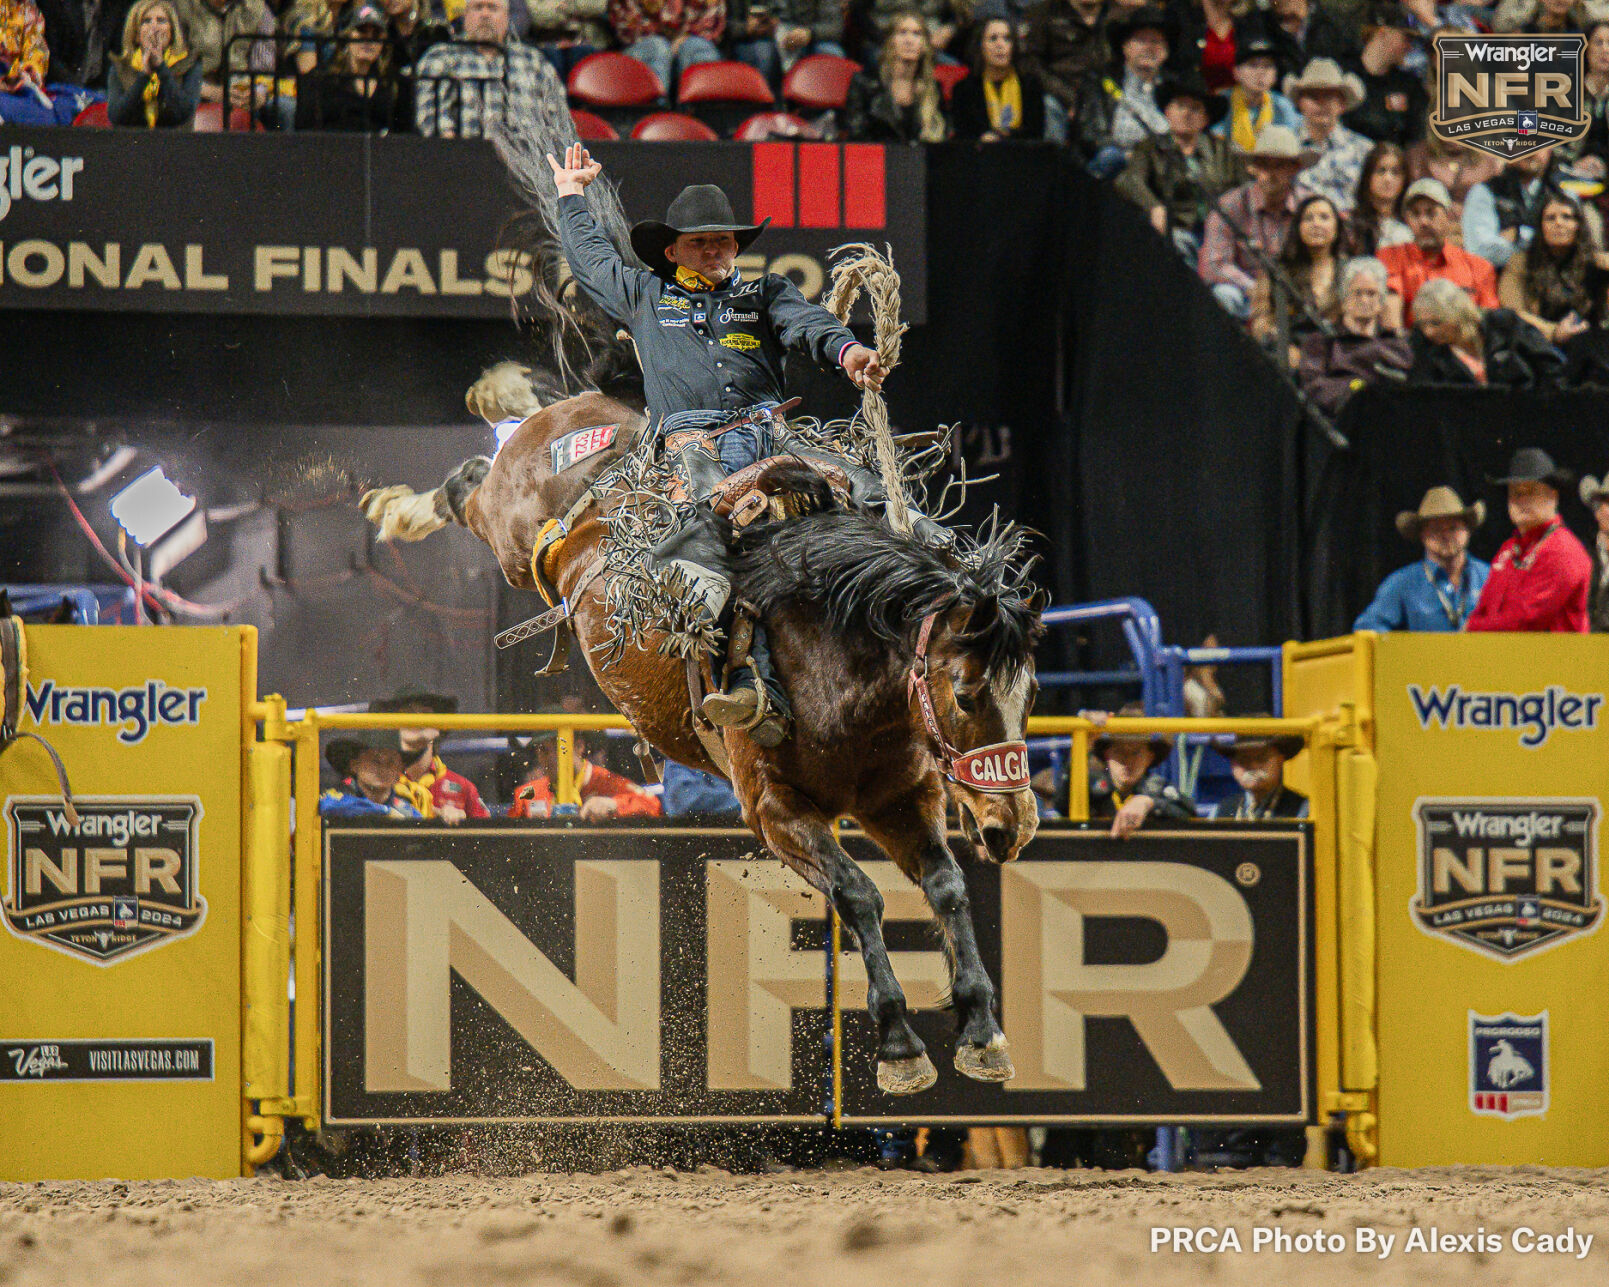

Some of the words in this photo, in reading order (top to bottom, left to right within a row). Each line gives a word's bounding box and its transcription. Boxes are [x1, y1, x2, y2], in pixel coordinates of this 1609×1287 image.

[0, 239, 228, 291] ONAL
[253, 245, 533, 297] FINALS
[25, 682, 205, 742] Wrangler
[1410, 686, 1602, 745] Wrangler
[1452, 811, 1563, 847] Wrangler
[25, 847, 182, 895] NFR
[1433, 847, 1582, 894] NFR
[26, 914, 55, 928] LAS
[59, 905, 109, 922] VEGAS
[141, 911, 182, 927] 2024
[364, 859, 1263, 1091] NFR
[89, 1049, 199, 1072] VISITLASVEGAS.COM
